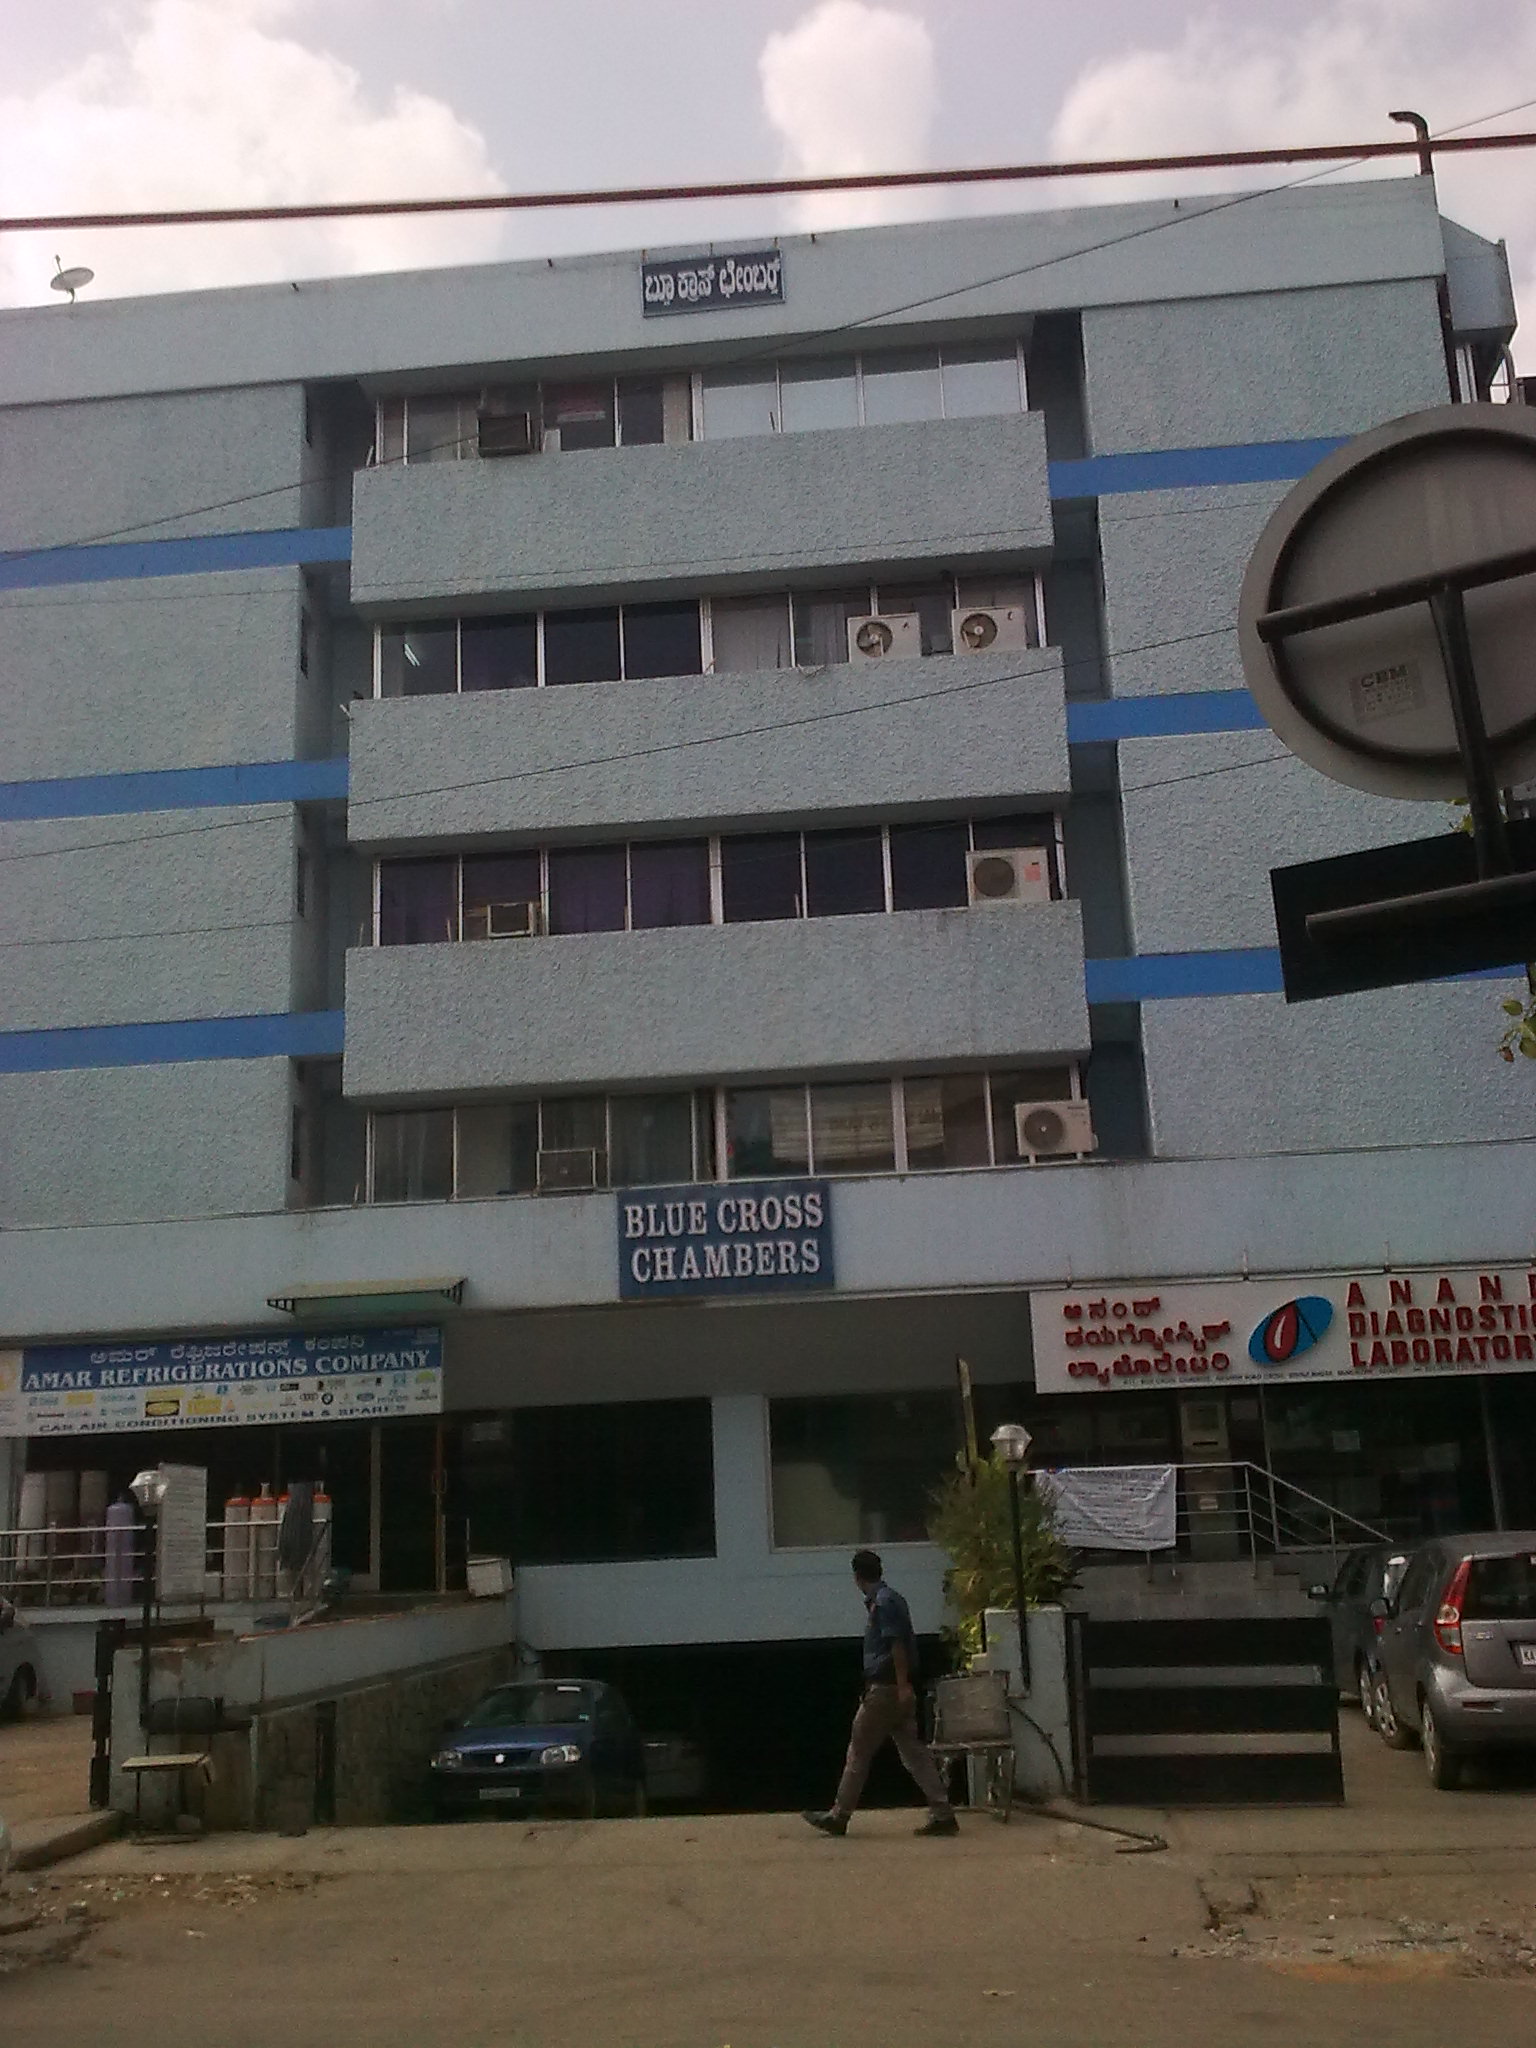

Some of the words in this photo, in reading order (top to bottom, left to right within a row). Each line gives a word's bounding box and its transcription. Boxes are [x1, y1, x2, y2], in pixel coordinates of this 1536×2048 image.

[624, 1201, 708, 1239] BLUE
[716, 1192, 824, 1234] CROSS
[630, 1239, 821, 1283] CHAMBERS
[25, 1371, 91, 1391] AMAR
[101, 1357, 308, 1386] REFRIGERATIONS
[314, 1349, 430, 1374] COMPANY
[1350, 1334, 1536, 1368] LABORATOR
